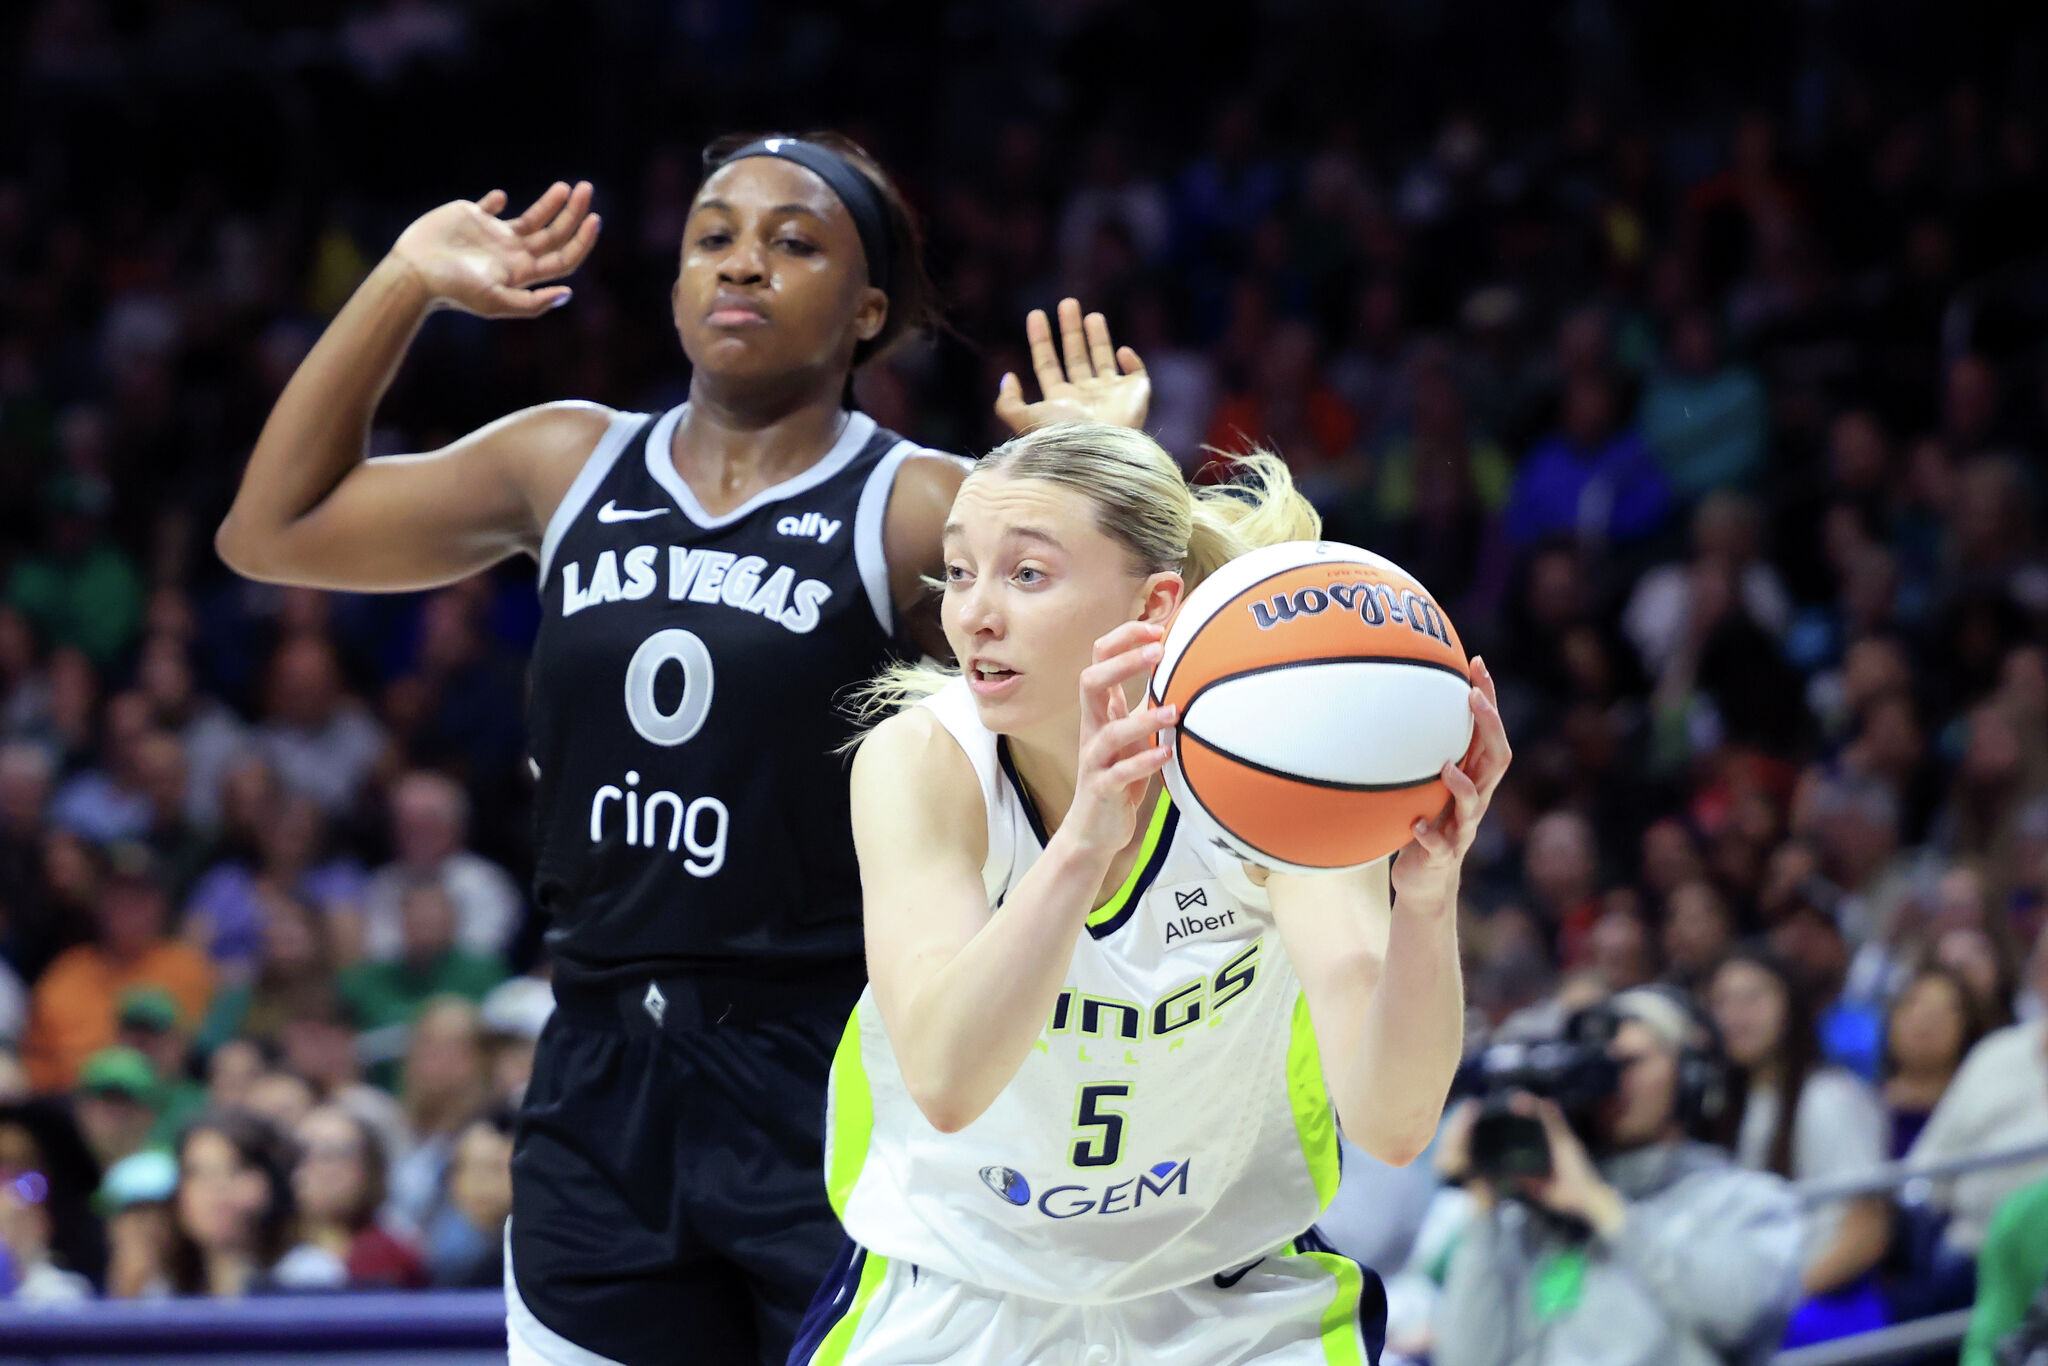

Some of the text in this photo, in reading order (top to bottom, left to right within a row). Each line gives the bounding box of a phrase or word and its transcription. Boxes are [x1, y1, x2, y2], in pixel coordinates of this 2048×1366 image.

[776, 512, 842, 544] ally
[562, 545, 833, 634] LAS VEGAS
[1248, 582, 1453, 648] Wilson
[624, 628, 715, 747] 0
[590, 770, 729, 878] ring
[1164, 908, 1236, 944] Albert
[1047, 936, 1264, 1044] INGS
[1068, 1081, 1135, 1171] 5
[1037, 1157, 1191, 1219] GEM
